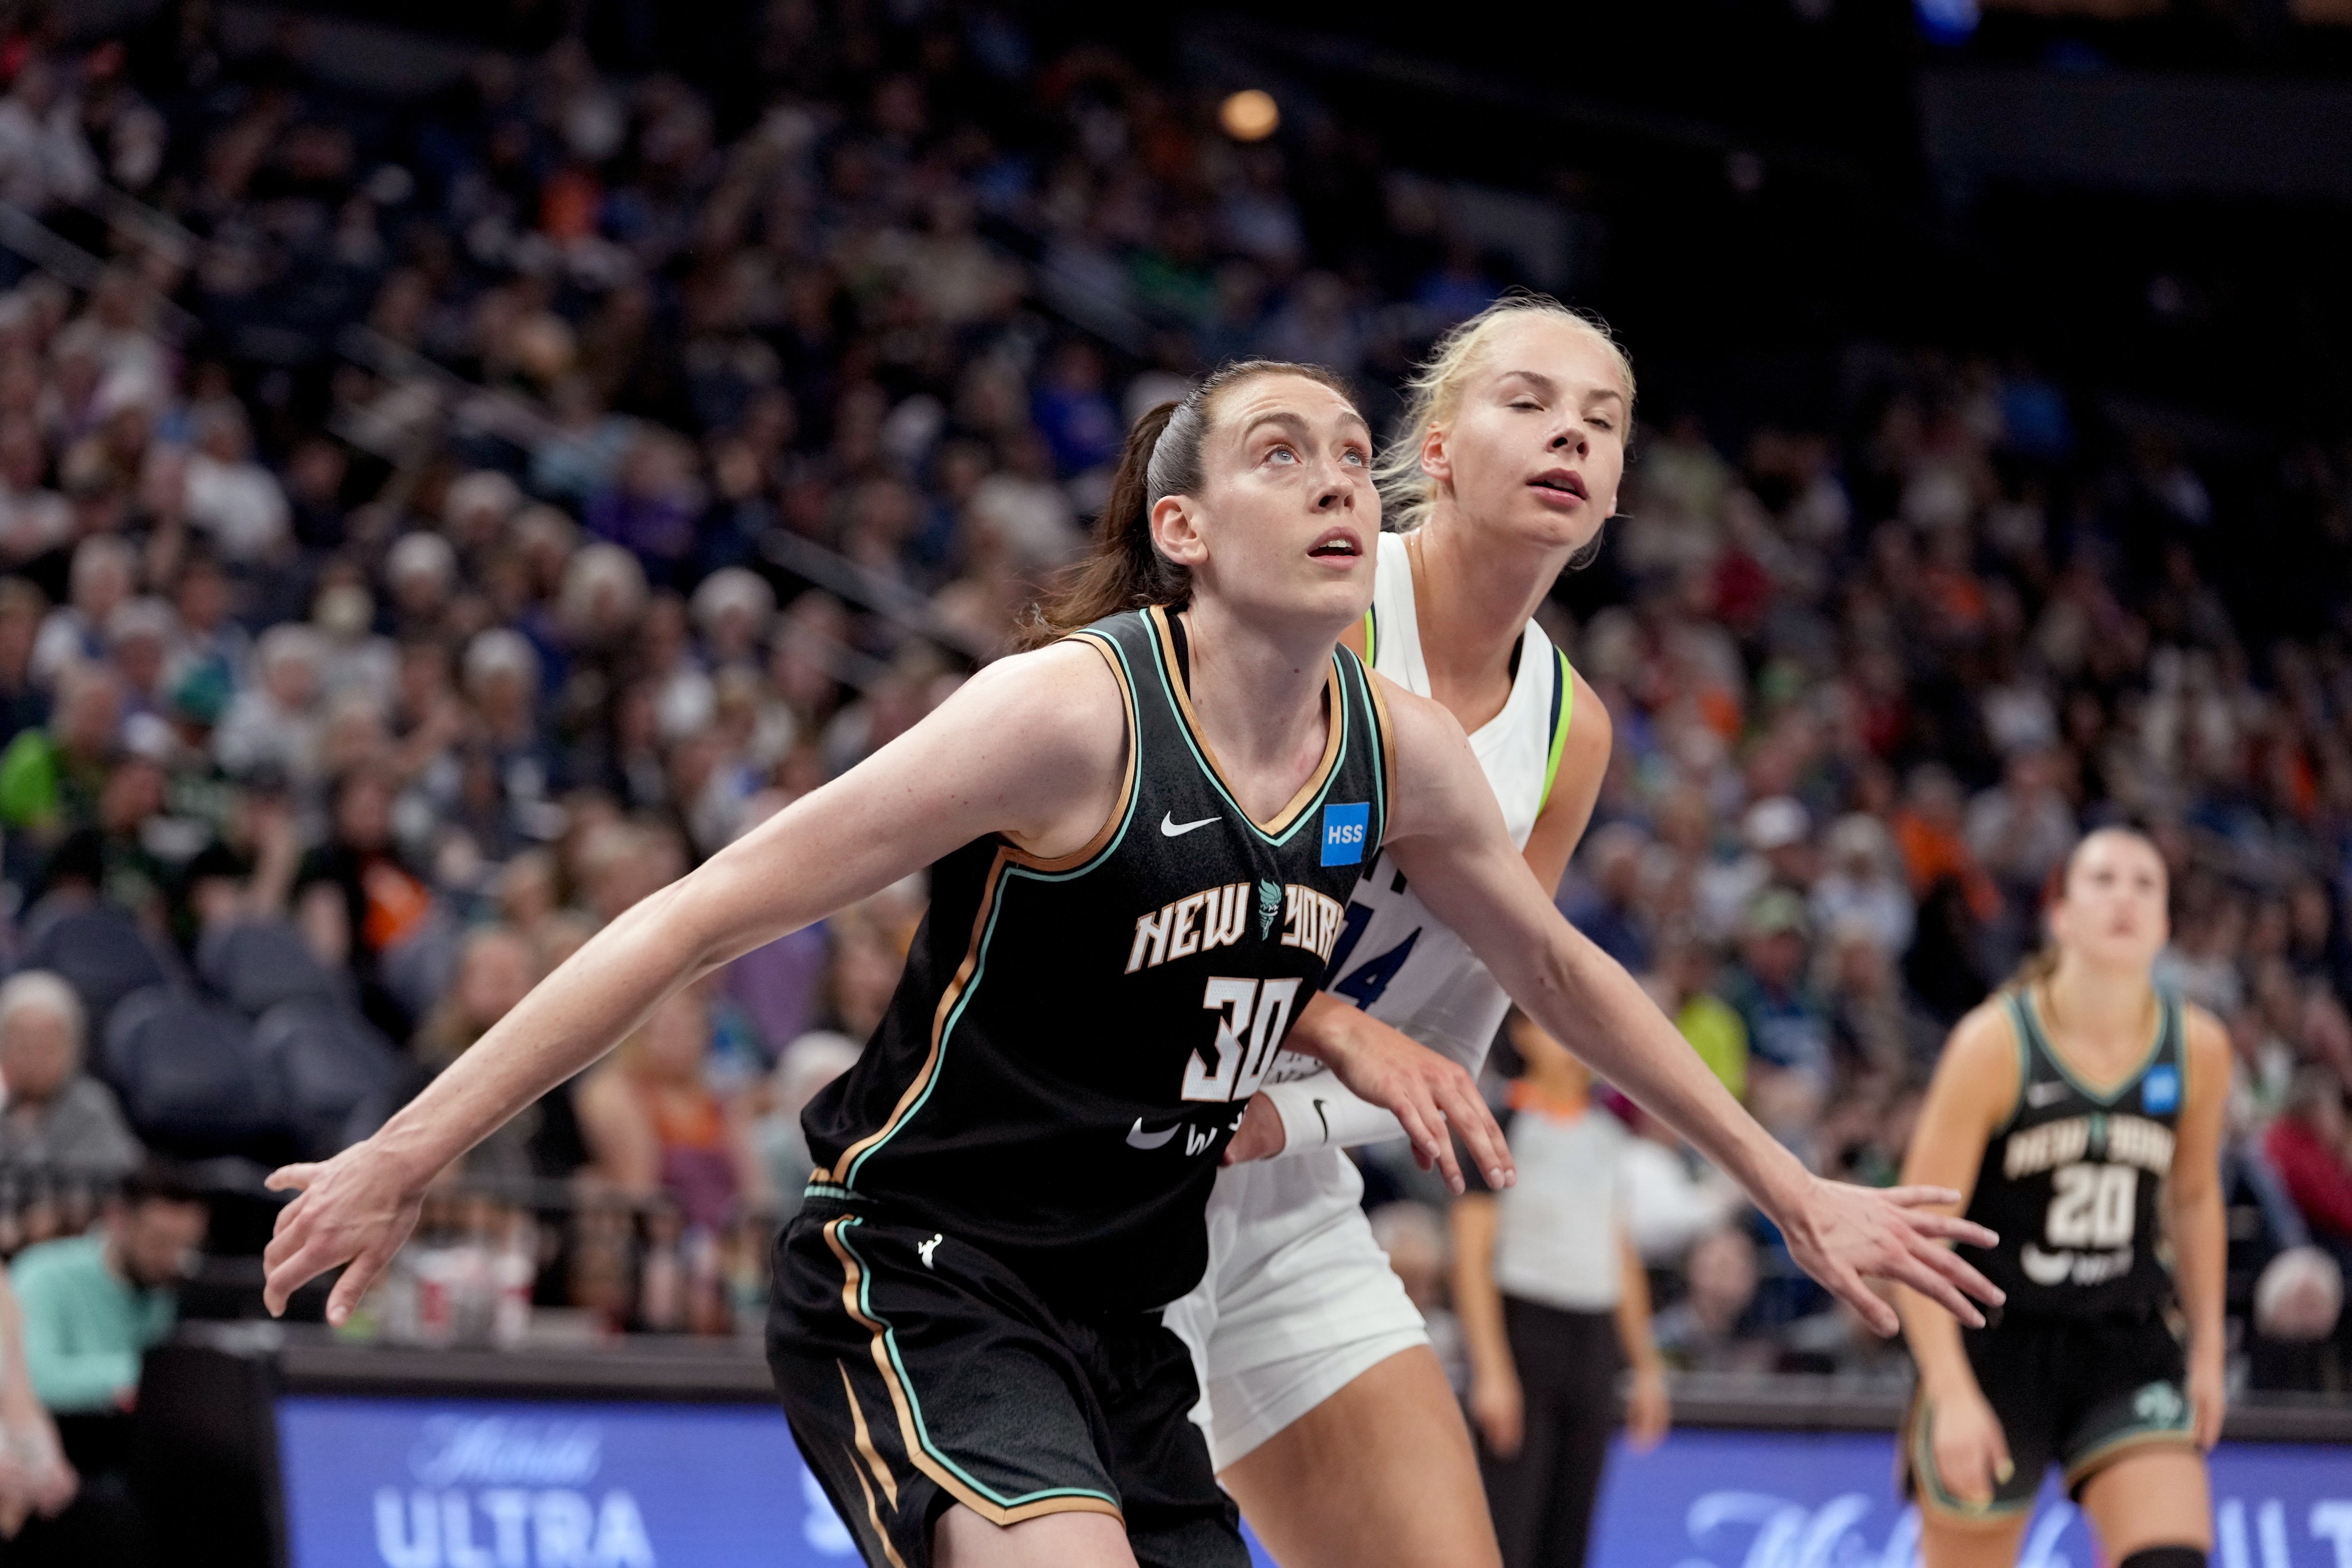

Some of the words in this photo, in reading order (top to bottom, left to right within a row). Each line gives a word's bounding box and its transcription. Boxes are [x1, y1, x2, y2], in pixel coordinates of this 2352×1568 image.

[1328, 824, 1363, 844] HSS
[1124, 882, 1251, 975] NEW
[1321, 900, 1422, 1011] 14
[1181, 976, 1303, 1103] 30
[2046, 1161, 2138, 1247] 20
[374, 1486, 657, 1568] ULTRA
